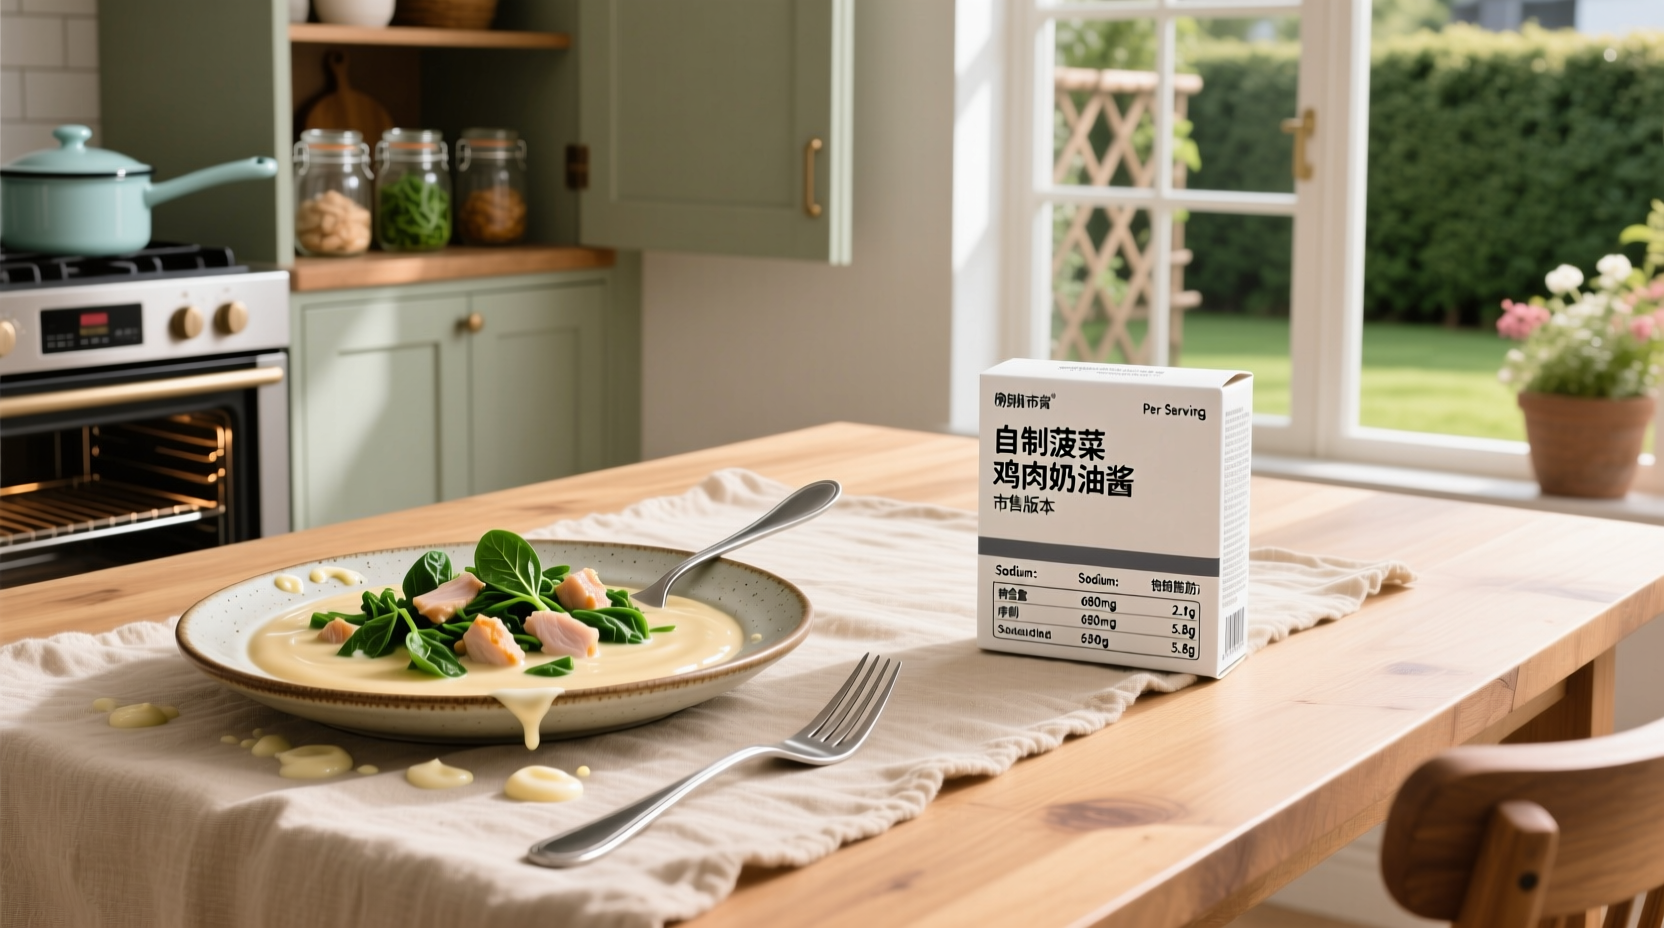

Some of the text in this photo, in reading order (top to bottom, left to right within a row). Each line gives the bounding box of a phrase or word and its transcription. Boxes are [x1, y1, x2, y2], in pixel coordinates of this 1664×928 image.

[1143, 402, 1162, 416] Per
[995, 424, 1106, 461] 自制菠菜
[993, 459, 1135, 498] 鸡肉奶油酱
[995, 564, 1038, 579] Sodium:
[1078, 572, 1119, 587] Sodium:
[1081, 596, 1117, 612] 680mg
